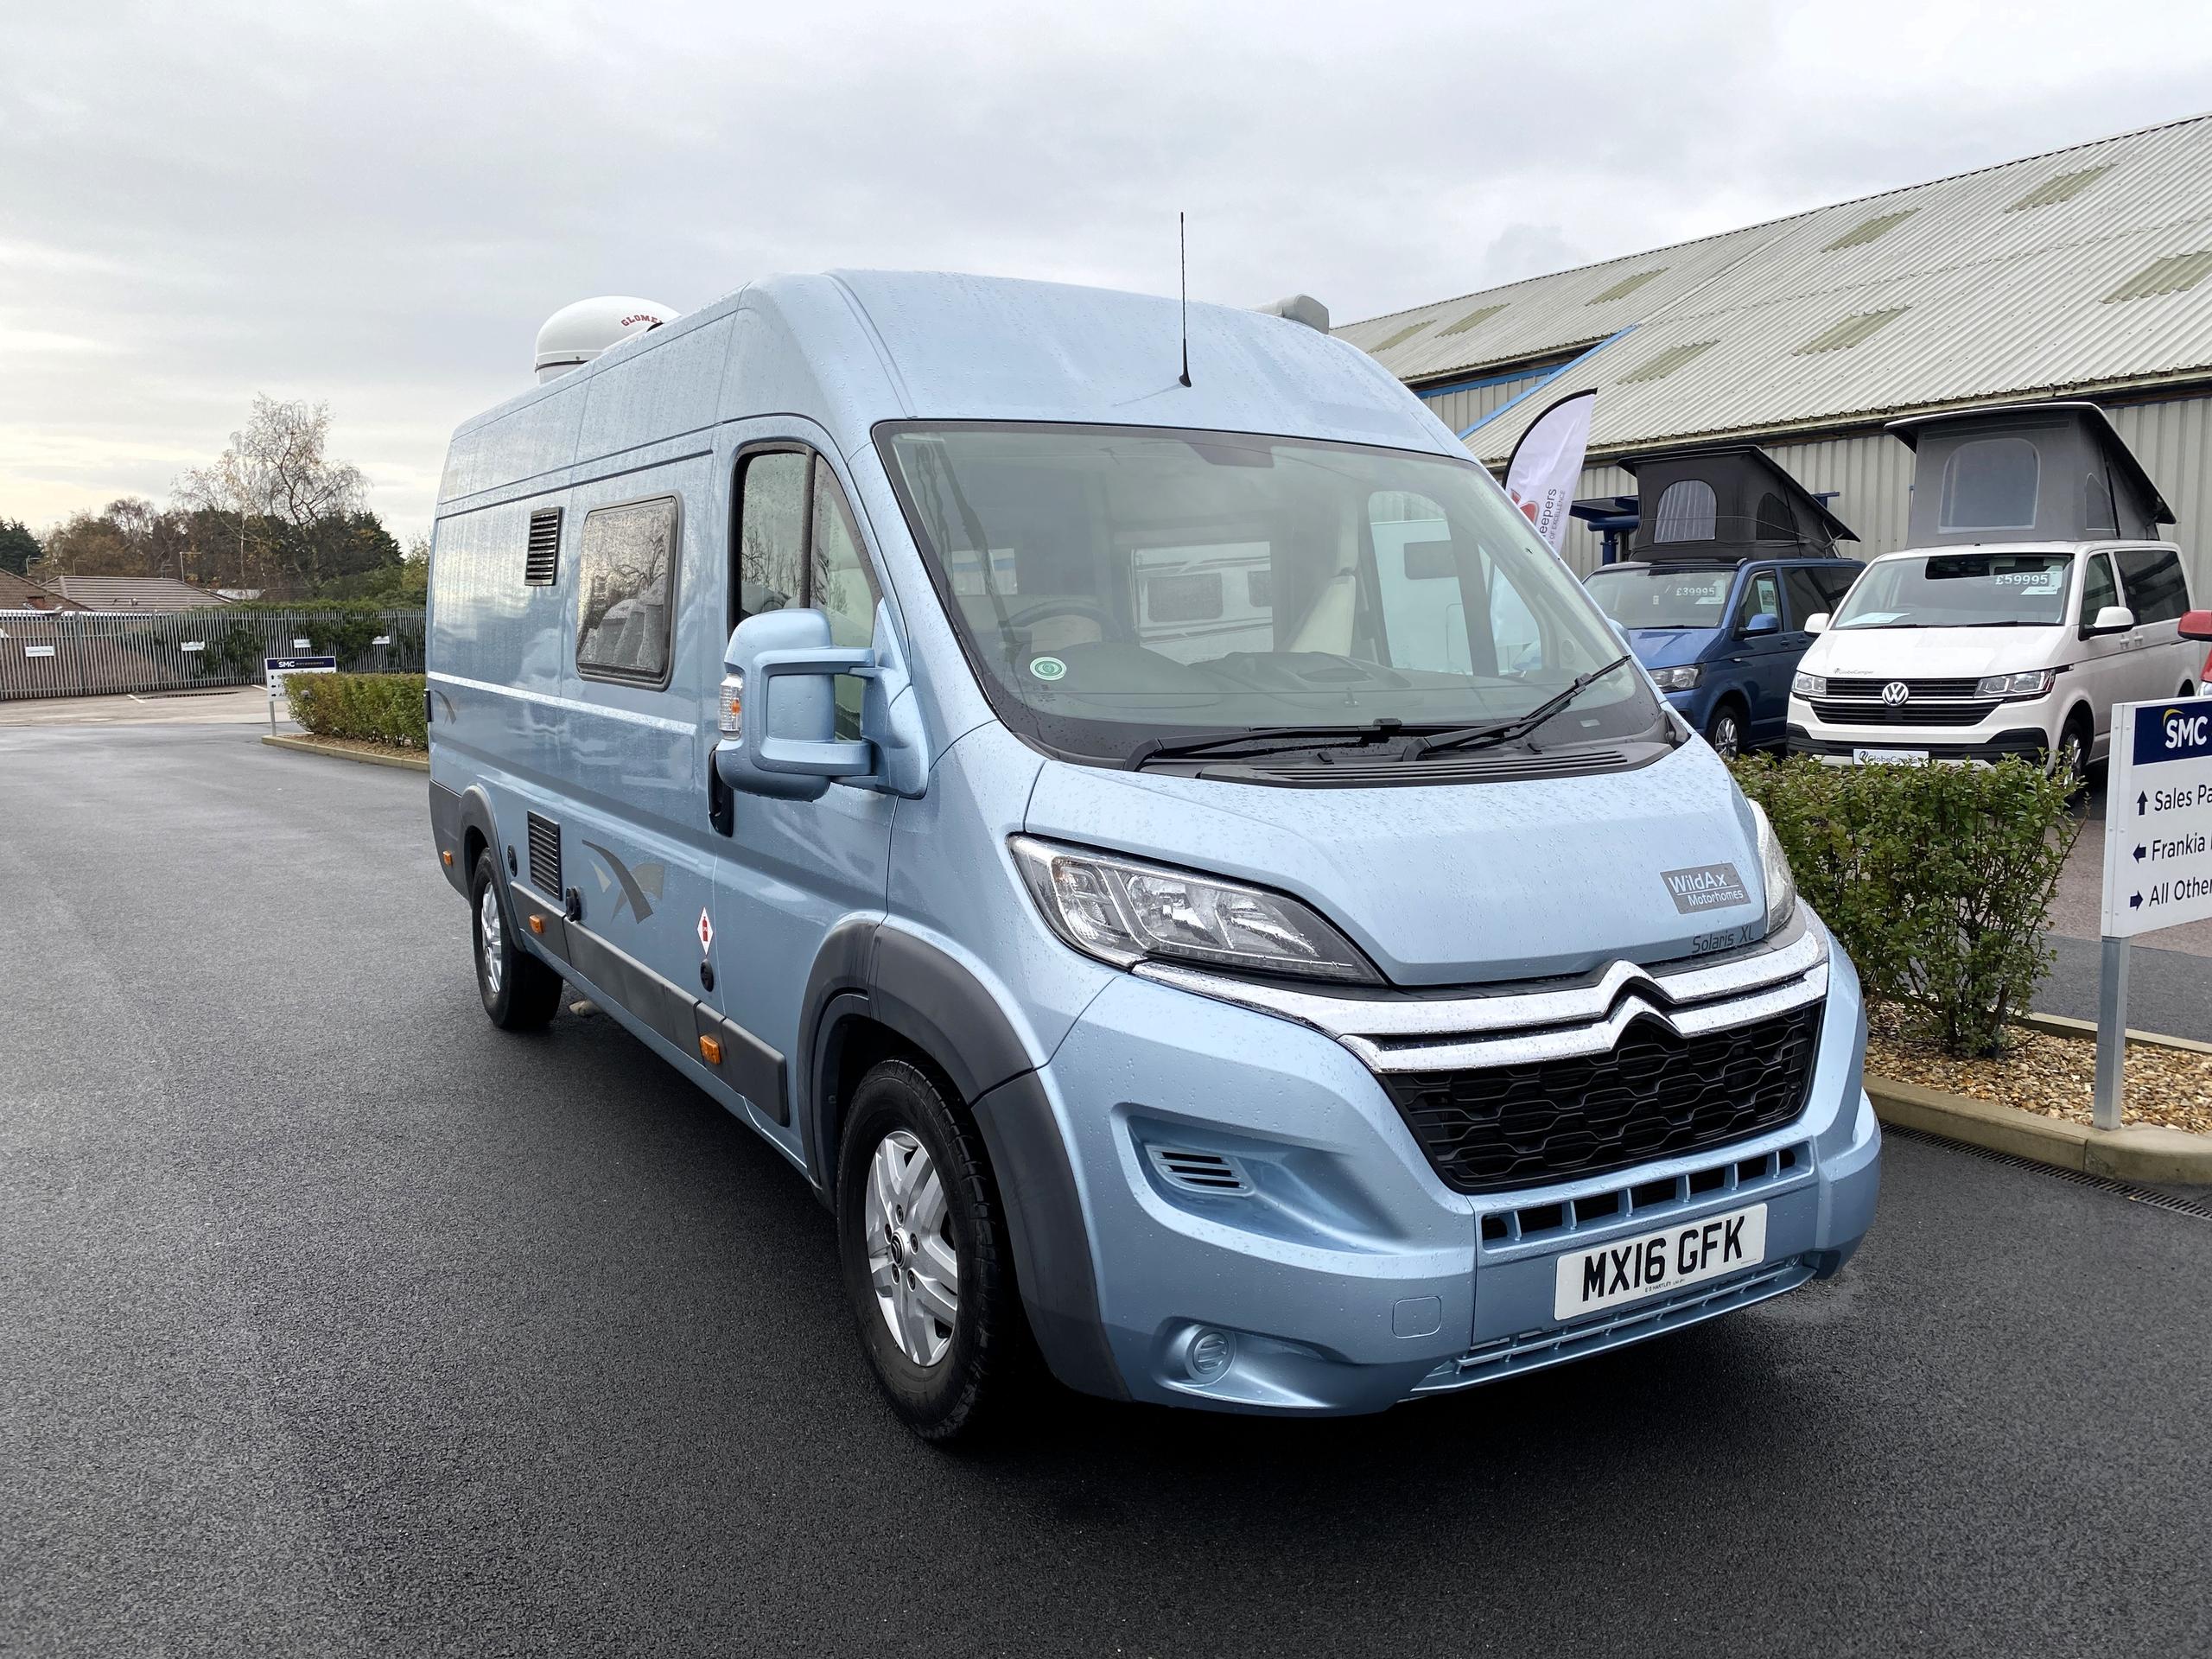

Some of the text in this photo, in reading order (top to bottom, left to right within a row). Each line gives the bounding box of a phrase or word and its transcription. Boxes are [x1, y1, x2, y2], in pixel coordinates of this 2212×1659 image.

[621, 315, 664, 327] GLOME
[1539, 488, 1557, 537] eepers
[1675, 587, 1715, 596] £39995
[1995, 575, 2048, 585] £59995
[2164, 715, 2209, 749] SMC
[2154, 787, 2192, 811] Sales
[2152, 831, 2205, 861] Frankia
[1668, 871, 1728, 893] WildAx
[2148, 881, 2169, 907] All
[1688, 889, 1744, 906] Motorhomes
[1692, 925, 1754, 954] Solaris XL
[1582, 1215, 1745, 1302] MX16 GFK
